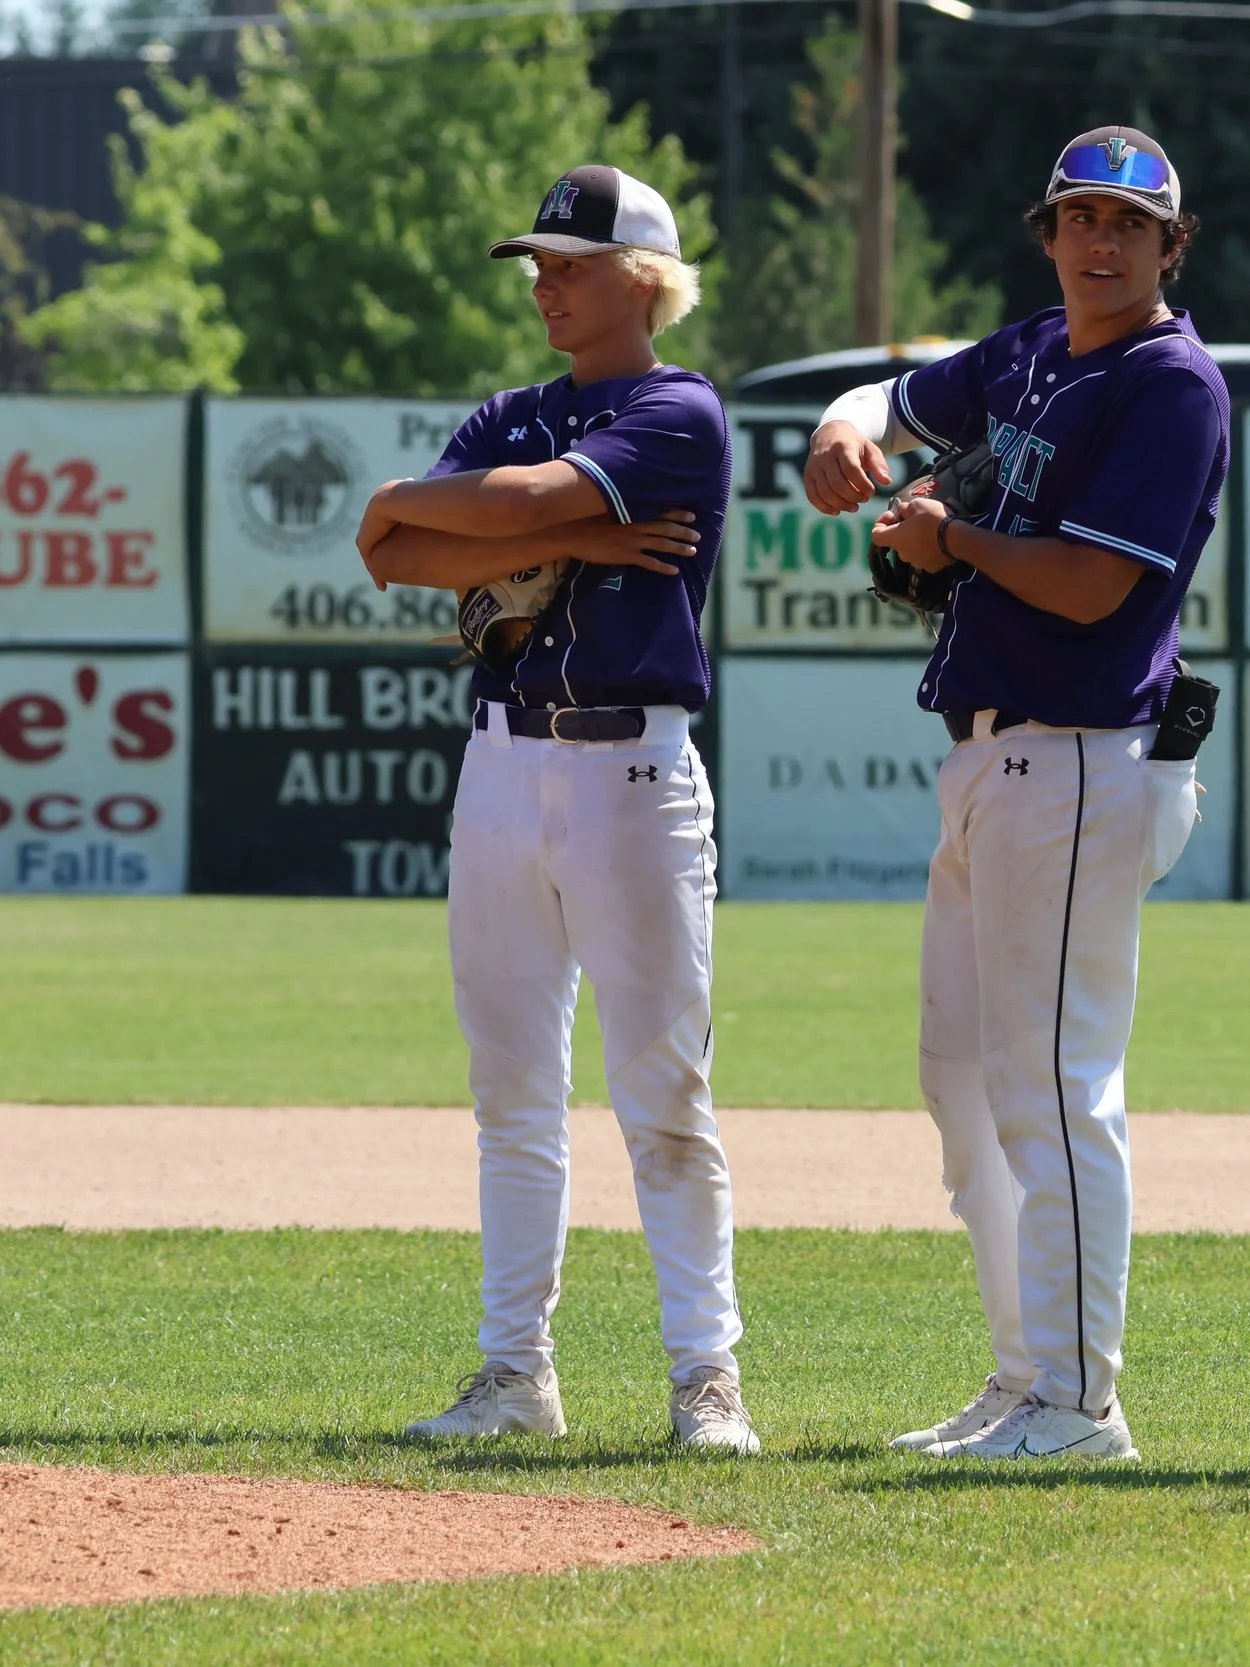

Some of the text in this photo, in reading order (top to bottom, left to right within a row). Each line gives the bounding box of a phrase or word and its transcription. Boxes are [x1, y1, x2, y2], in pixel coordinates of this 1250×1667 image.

[212, 667, 345, 730] HILL
[279, 752, 447, 804] AUTO
[18, 842, 147, 886] Falls
